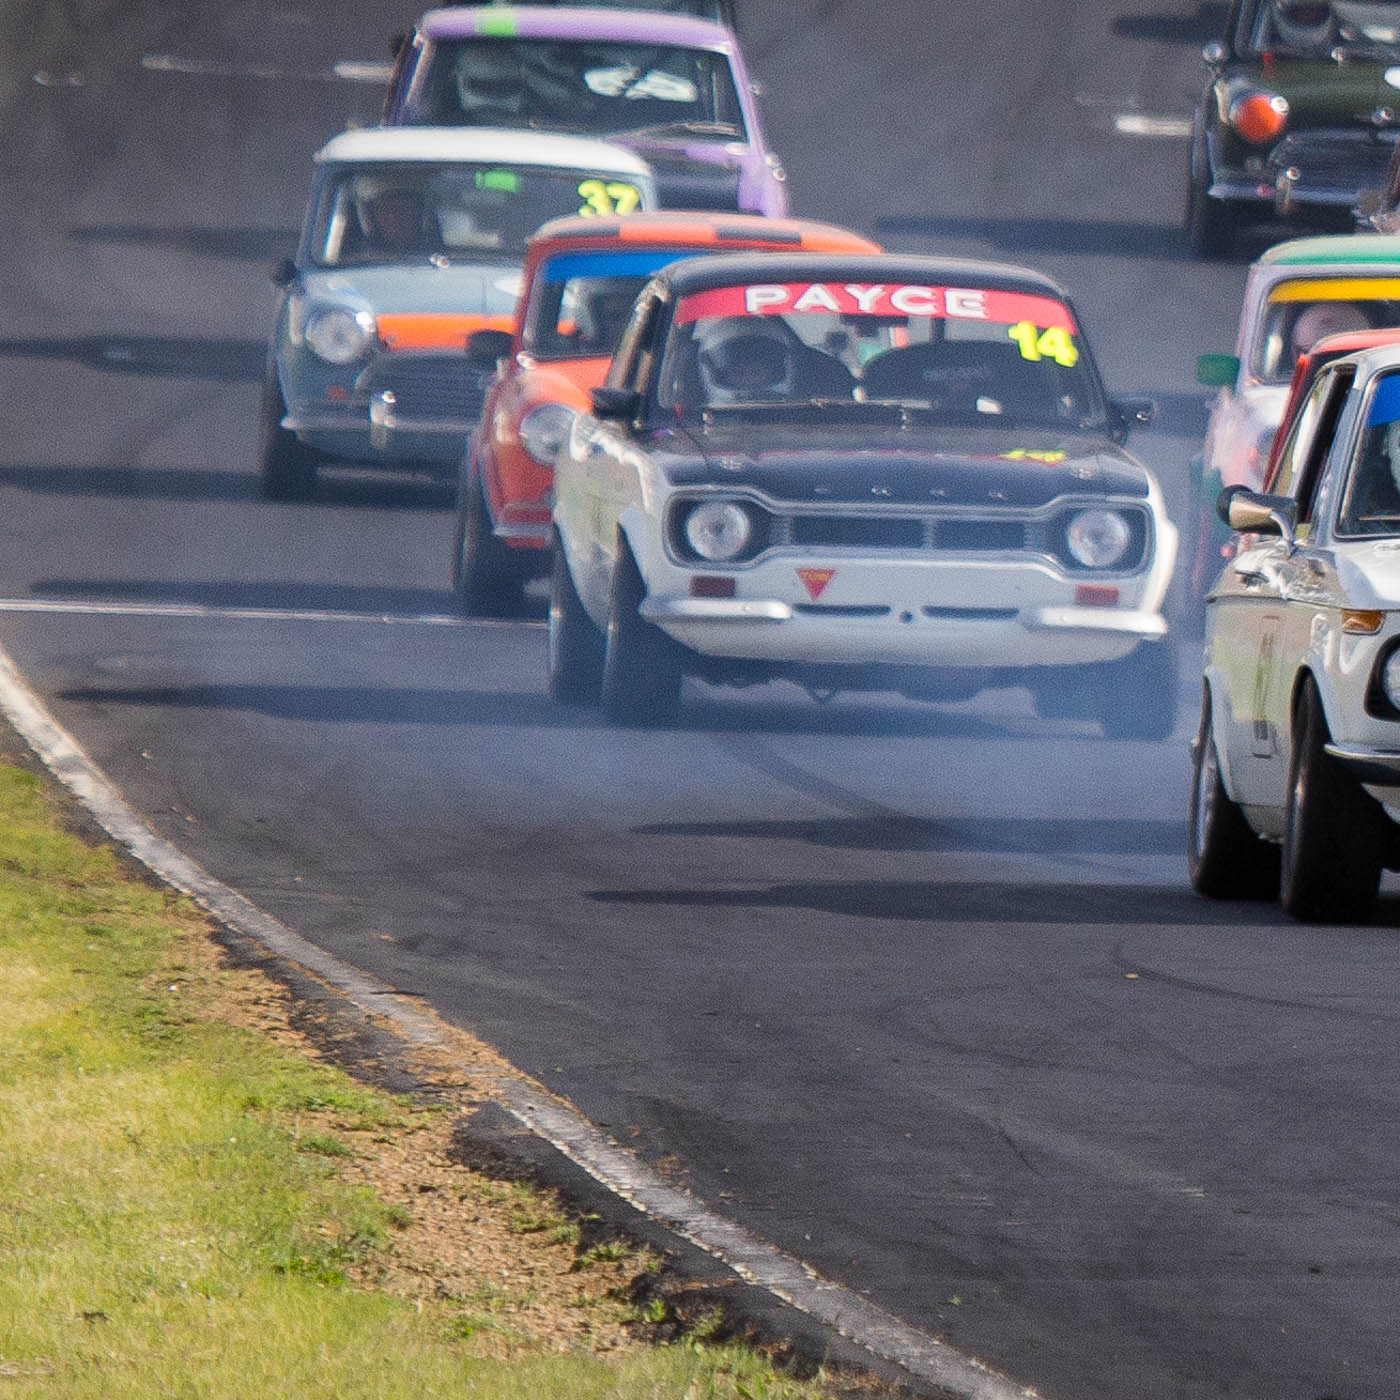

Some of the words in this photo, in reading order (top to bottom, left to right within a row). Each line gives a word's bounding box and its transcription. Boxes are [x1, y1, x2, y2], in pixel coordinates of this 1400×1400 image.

[577, 179, 640, 218] 37
[744, 283, 990, 319] PAYCE
[1007, 320, 1080, 368] 14
